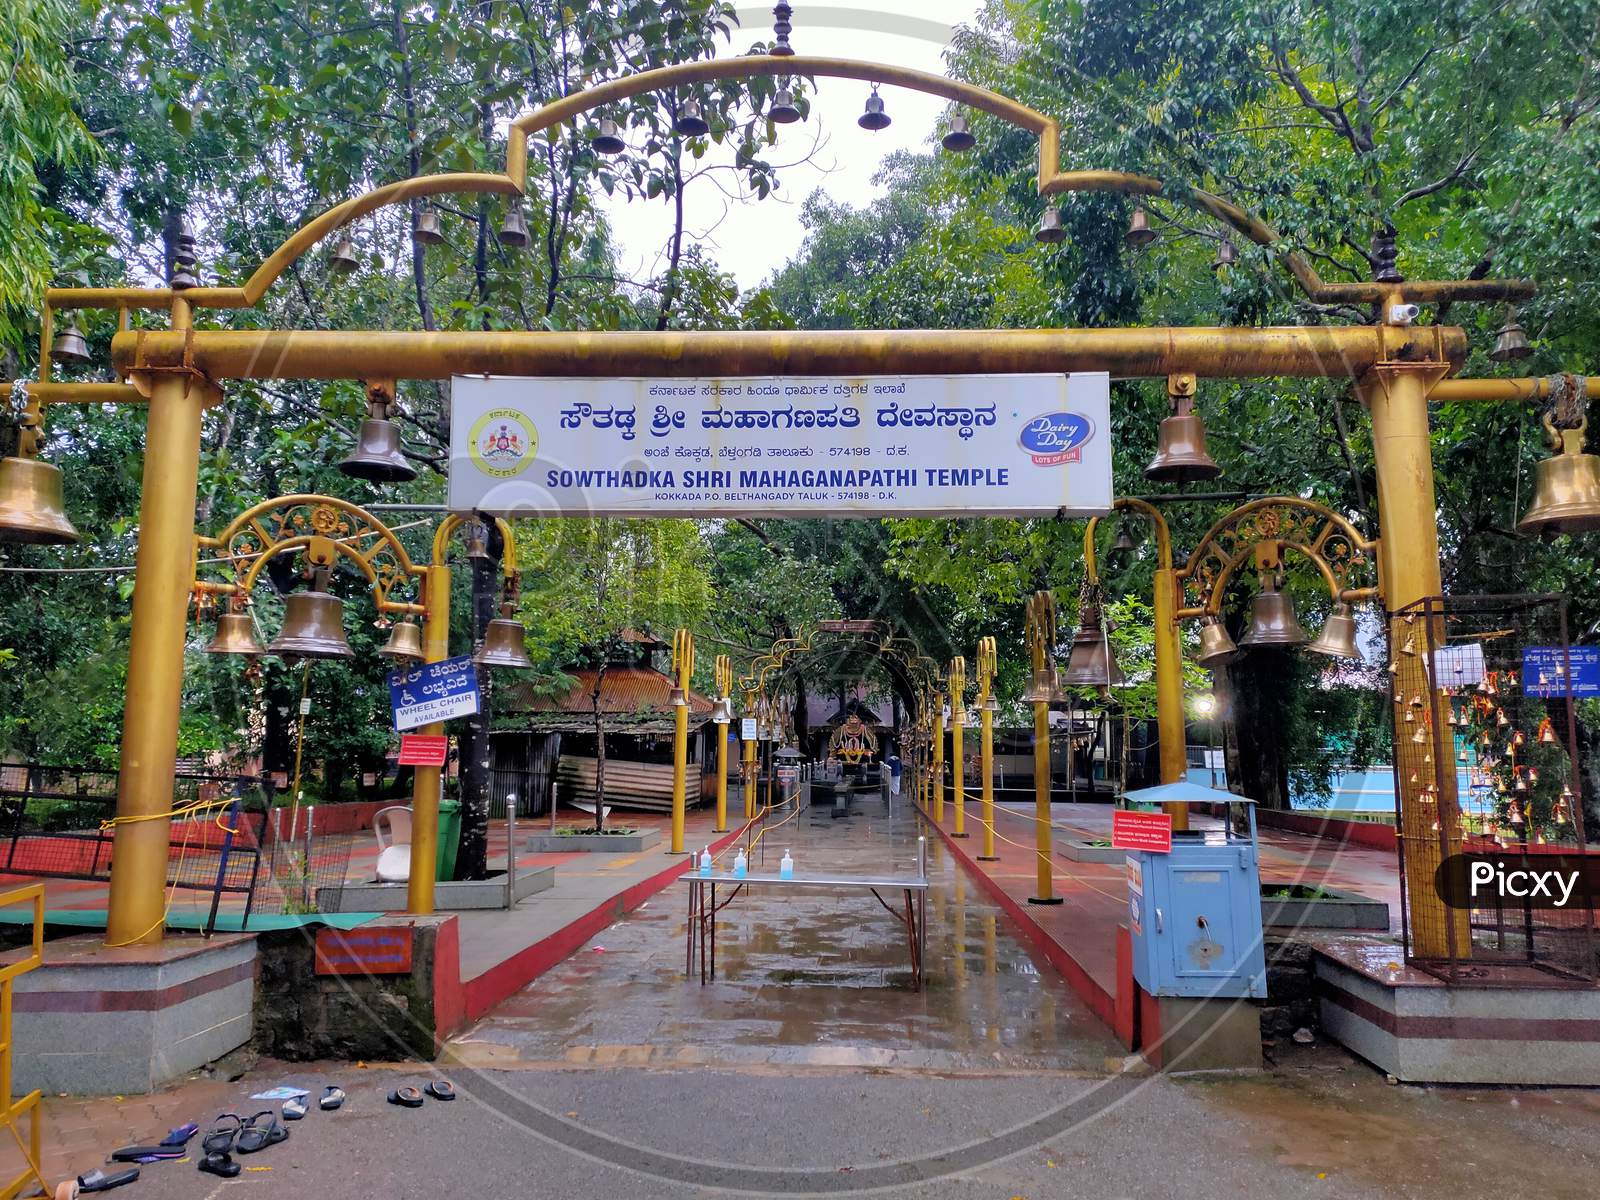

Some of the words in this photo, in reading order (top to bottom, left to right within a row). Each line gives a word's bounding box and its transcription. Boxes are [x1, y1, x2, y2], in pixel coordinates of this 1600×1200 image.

[701, 385, 741, 396] ಸರಕಾರ
[747, 384, 779, 395] ಹಿಂದೂ
[560, 402, 637, 441] ಸೌತಡ್ಕ
[650, 405, 686, 437] ಶ್ರೀ
[701, 403, 861, 429] ಮಹಾಗಣಪತಿ
[876, 400, 997, 441] ದೇವಸ್ಥಾನ
[1031, 417, 1079, 437] Dairy
[829, 447, 871, 456] 574198
[1037, 431, 1073, 452] Day
[547, 470, 675, 488] SOWTHADKA
[682, 470, 731, 488] SHRI
[740, 468, 917, 488] MAHAGANAPATHI
[925, 468, 1009, 486] TEMPLE
[655, 492, 702, 501] KOKKADA
[724, 492, 795, 500] BELTHANGADY
[798, 492, 828, 500] TALUK
[837, 491, 869, 500] 574198
[878, 491, 897, 500] D.K.
[400, 701, 437, 717] WHEEL
[439, 694, 472, 708] CHAIR
[414, 708, 455, 723] AVAILABLE
